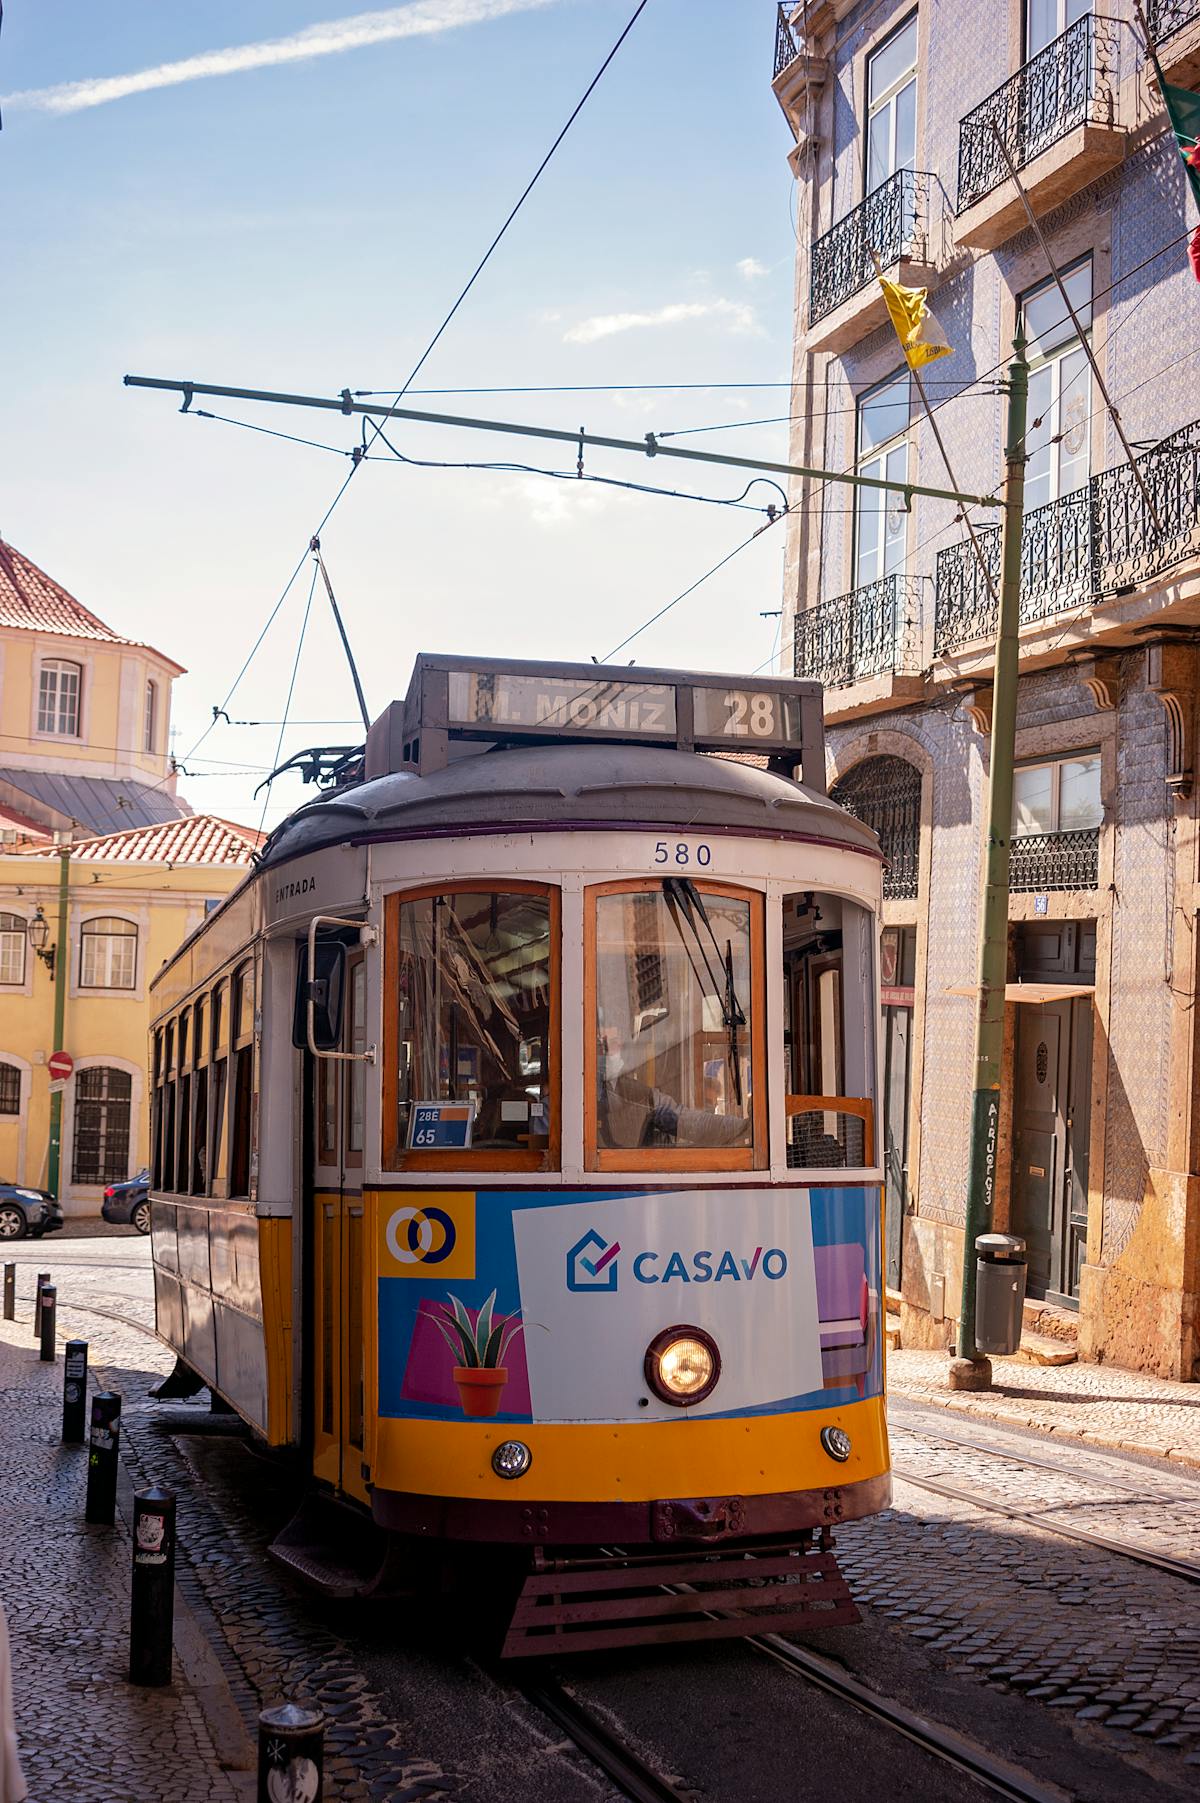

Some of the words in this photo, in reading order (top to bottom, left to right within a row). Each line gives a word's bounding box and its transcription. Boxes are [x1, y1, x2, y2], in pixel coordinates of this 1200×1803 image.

[536, 692, 667, 732] MONIZ
[723, 693, 775, 736] 28
[654, 841, 711, 866] 580
[275, 876, 316, 904] ENTRADA
[419, 1111, 439, 1122] 28E
[416, 1129, 436, 1145] 65
[632, 1246, 788, 1285] CASAVO
